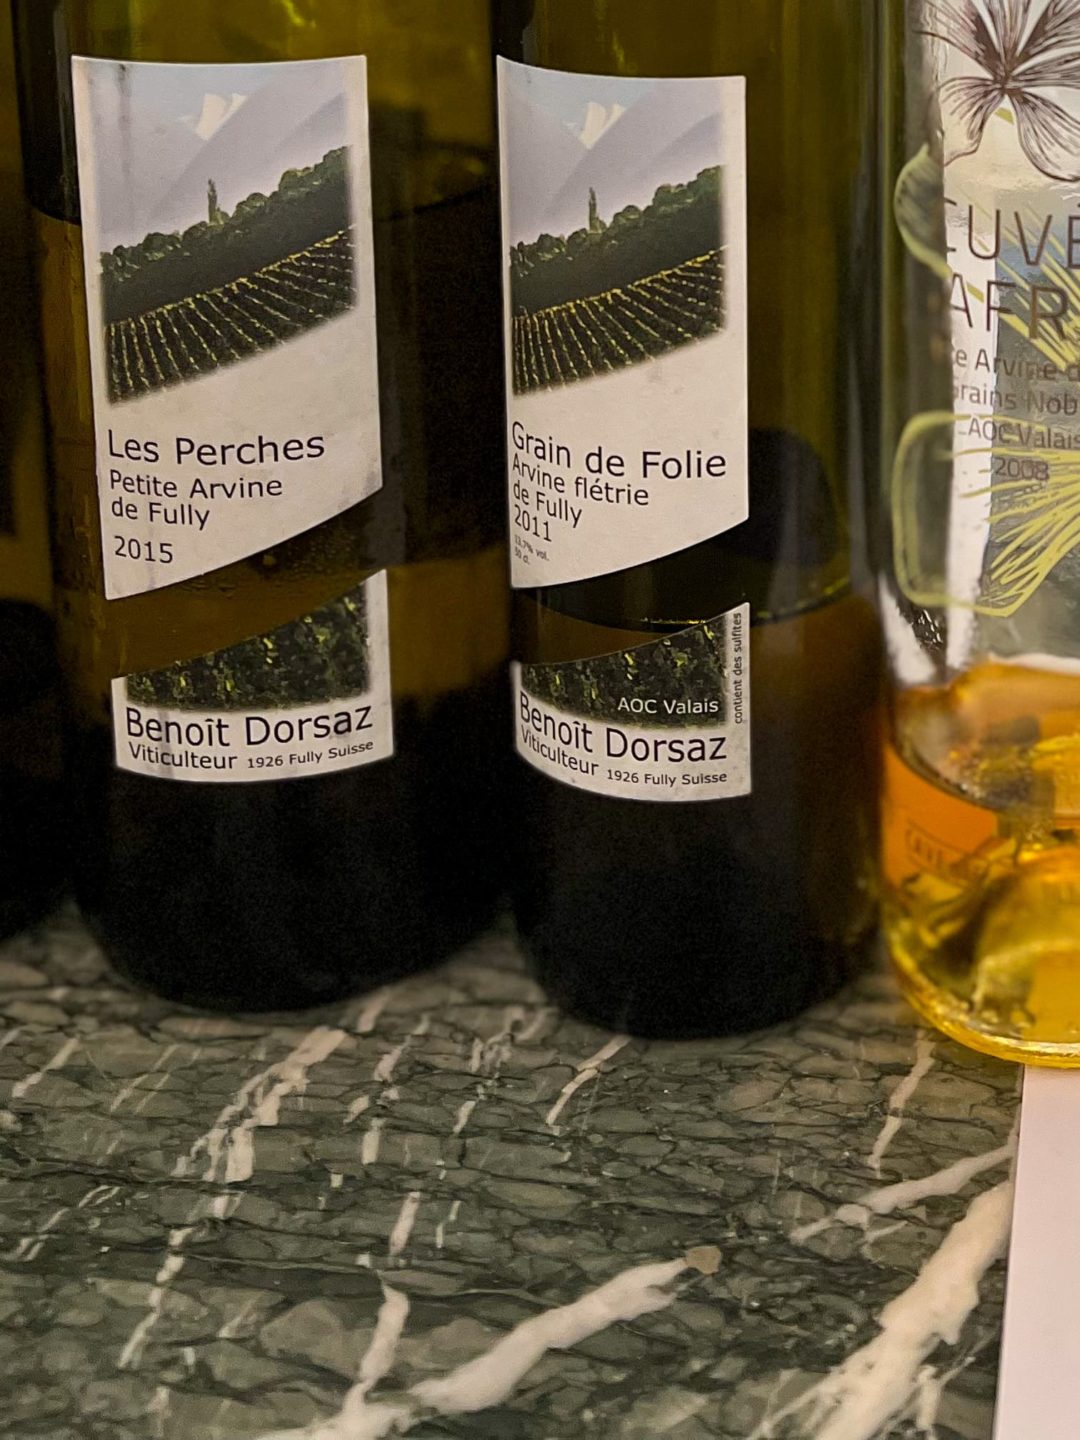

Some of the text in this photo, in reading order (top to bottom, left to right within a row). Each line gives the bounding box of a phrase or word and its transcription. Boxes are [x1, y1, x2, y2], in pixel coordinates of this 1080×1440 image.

[974, 348, 1064, 382] Arvine
[107, 428, 326, 466] Les Perches
[511, 420, 728, 479] Grain de Folie
[109, 468, 284, 500] Petite Arvine
[512, 452, 650, 506] Arvine flétrie
[994, 457, 1050, 481] 2008
[110, 496, 211, 531] de Fully
[512, 479, 583, 529] de Fully
[513, 503, 553, 543] 2011
[114, 535, 174, 564] 2015
[731, 612, 743, 725] contient des sulfites
[616, 696, 719, 715] AOC Valais
[125, 705, 374, 747] Benoît Dorsaz
[519, 690, 728, 764] Benoît Dorsaz
[127, 740, 374, 770] Viticulteur 1926 Fully Suisse
[520, 724, 728, 788] Viticulteur 1926 Fully Suisse
